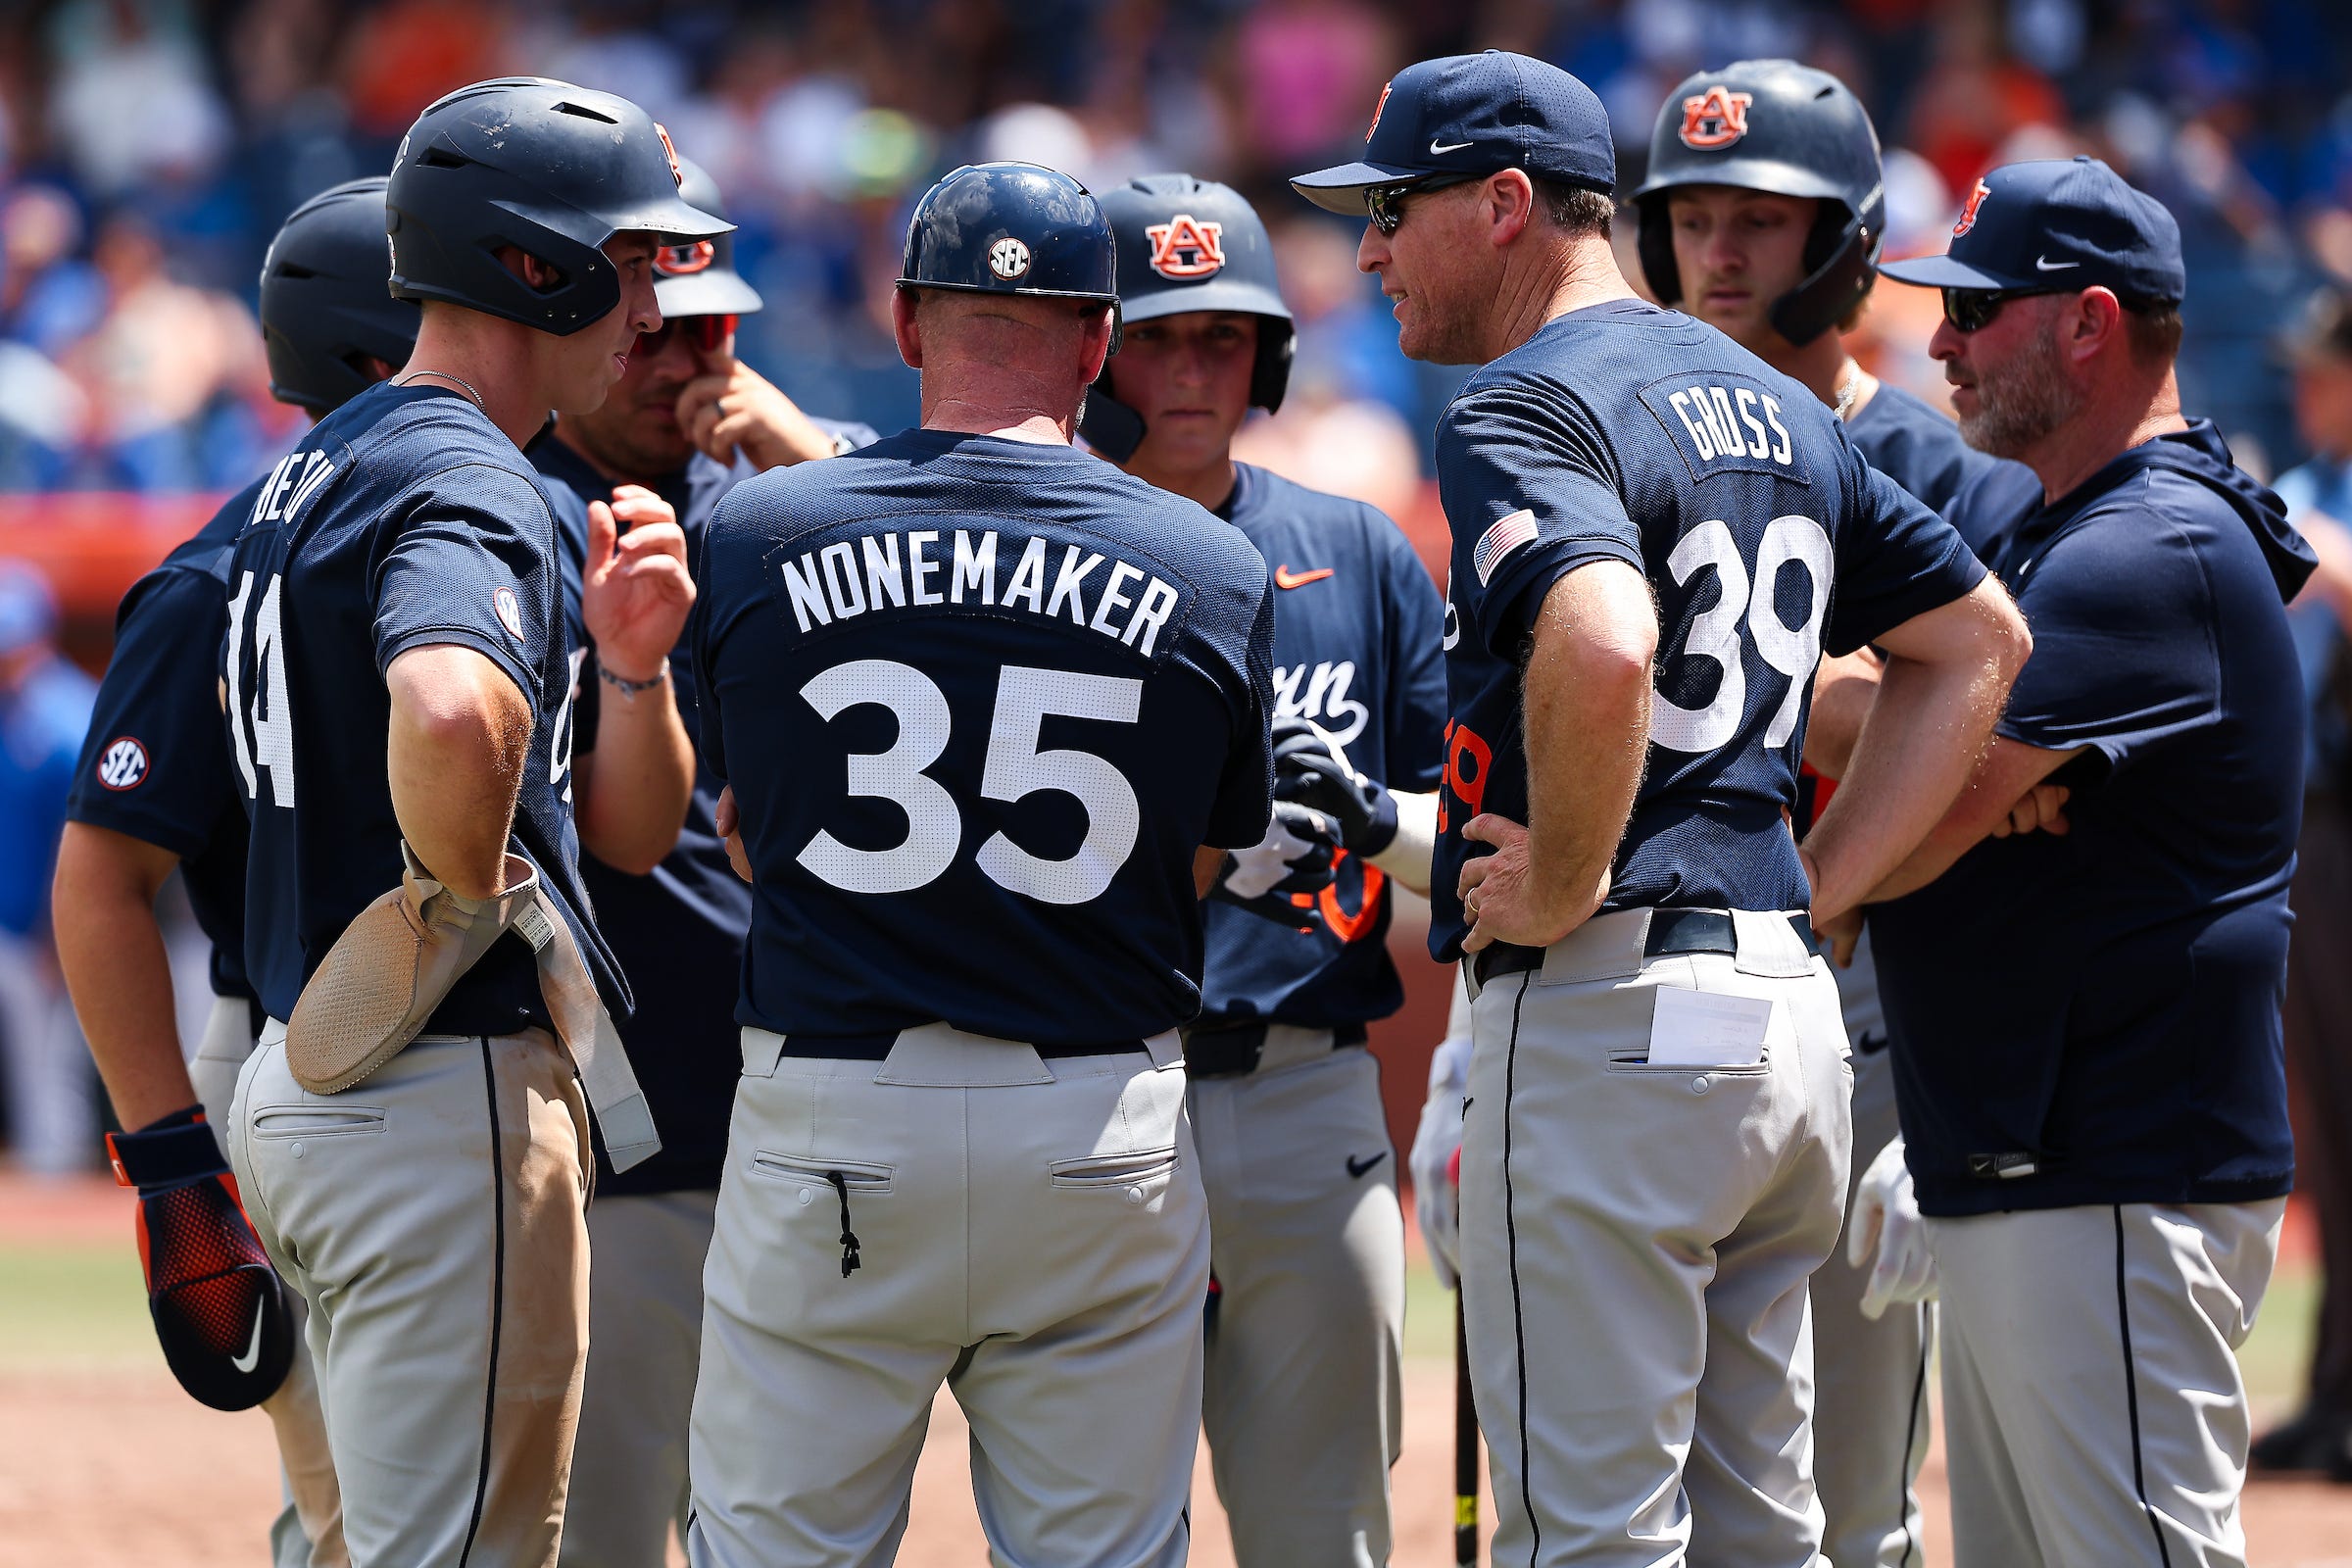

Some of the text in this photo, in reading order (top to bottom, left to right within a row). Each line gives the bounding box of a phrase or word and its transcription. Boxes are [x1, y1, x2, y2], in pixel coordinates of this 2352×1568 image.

[990, 239, 1029, 277] SEC
[1669, 386, 1792, 466] GROSS
[781, 529, 1179, 659] NONEMAKER
[1650, 514, 1835, 754] 39
[227, 569, 295, 808] 14
[100, 739, 146, 788] SEC
[795, 659, 1144, 905] 35
[1438, 716, 1493, 834] 9
